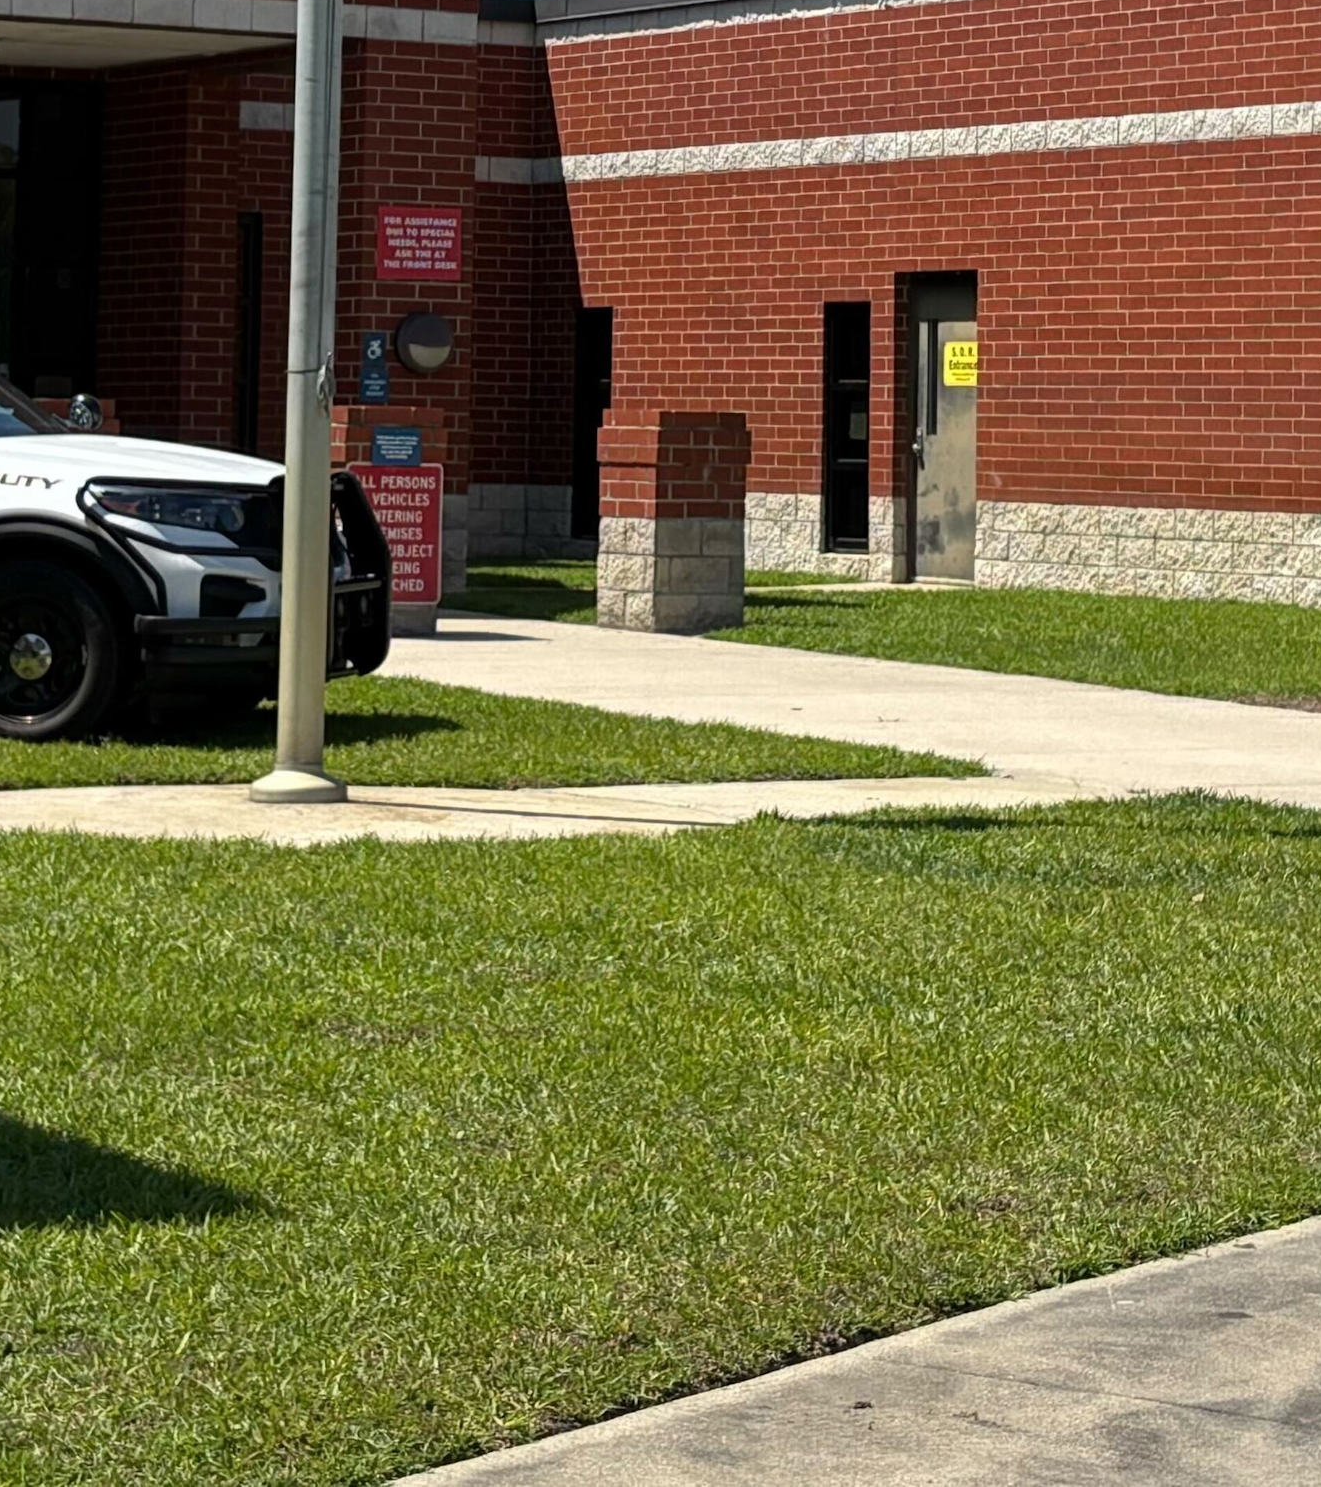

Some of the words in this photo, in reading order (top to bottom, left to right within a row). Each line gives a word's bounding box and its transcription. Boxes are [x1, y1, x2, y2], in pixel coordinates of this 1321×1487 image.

[383, 216, 402, 225] FOR
[404, 217, 458, 227] ASSISTANCE
[385, 225, 404, 235] DUE
[406, 227, 419, 237] TO
[420, 228, 455, 237] SPECIAL
[387, 237, 420, 248] NEEDS,
[421, 239, 453, 248] PLEASE
[394, 249, 413, 258] ASK
[383, 259, 400, 269] THE
[402, 260, 432, 269] FRONT
[434, 261, 458, 270] DESK
[360, 475, 376, 489] LL
[380, 475, 437, 490] PERSONS
[372, 492, 430, 507] VEHICLES
[373, 509, 423, 524] NTERING
[388, 544, 434, 558] UBJECT
[391, 561, 421, 575] EING
[391, 578, 425, 592] CHED
